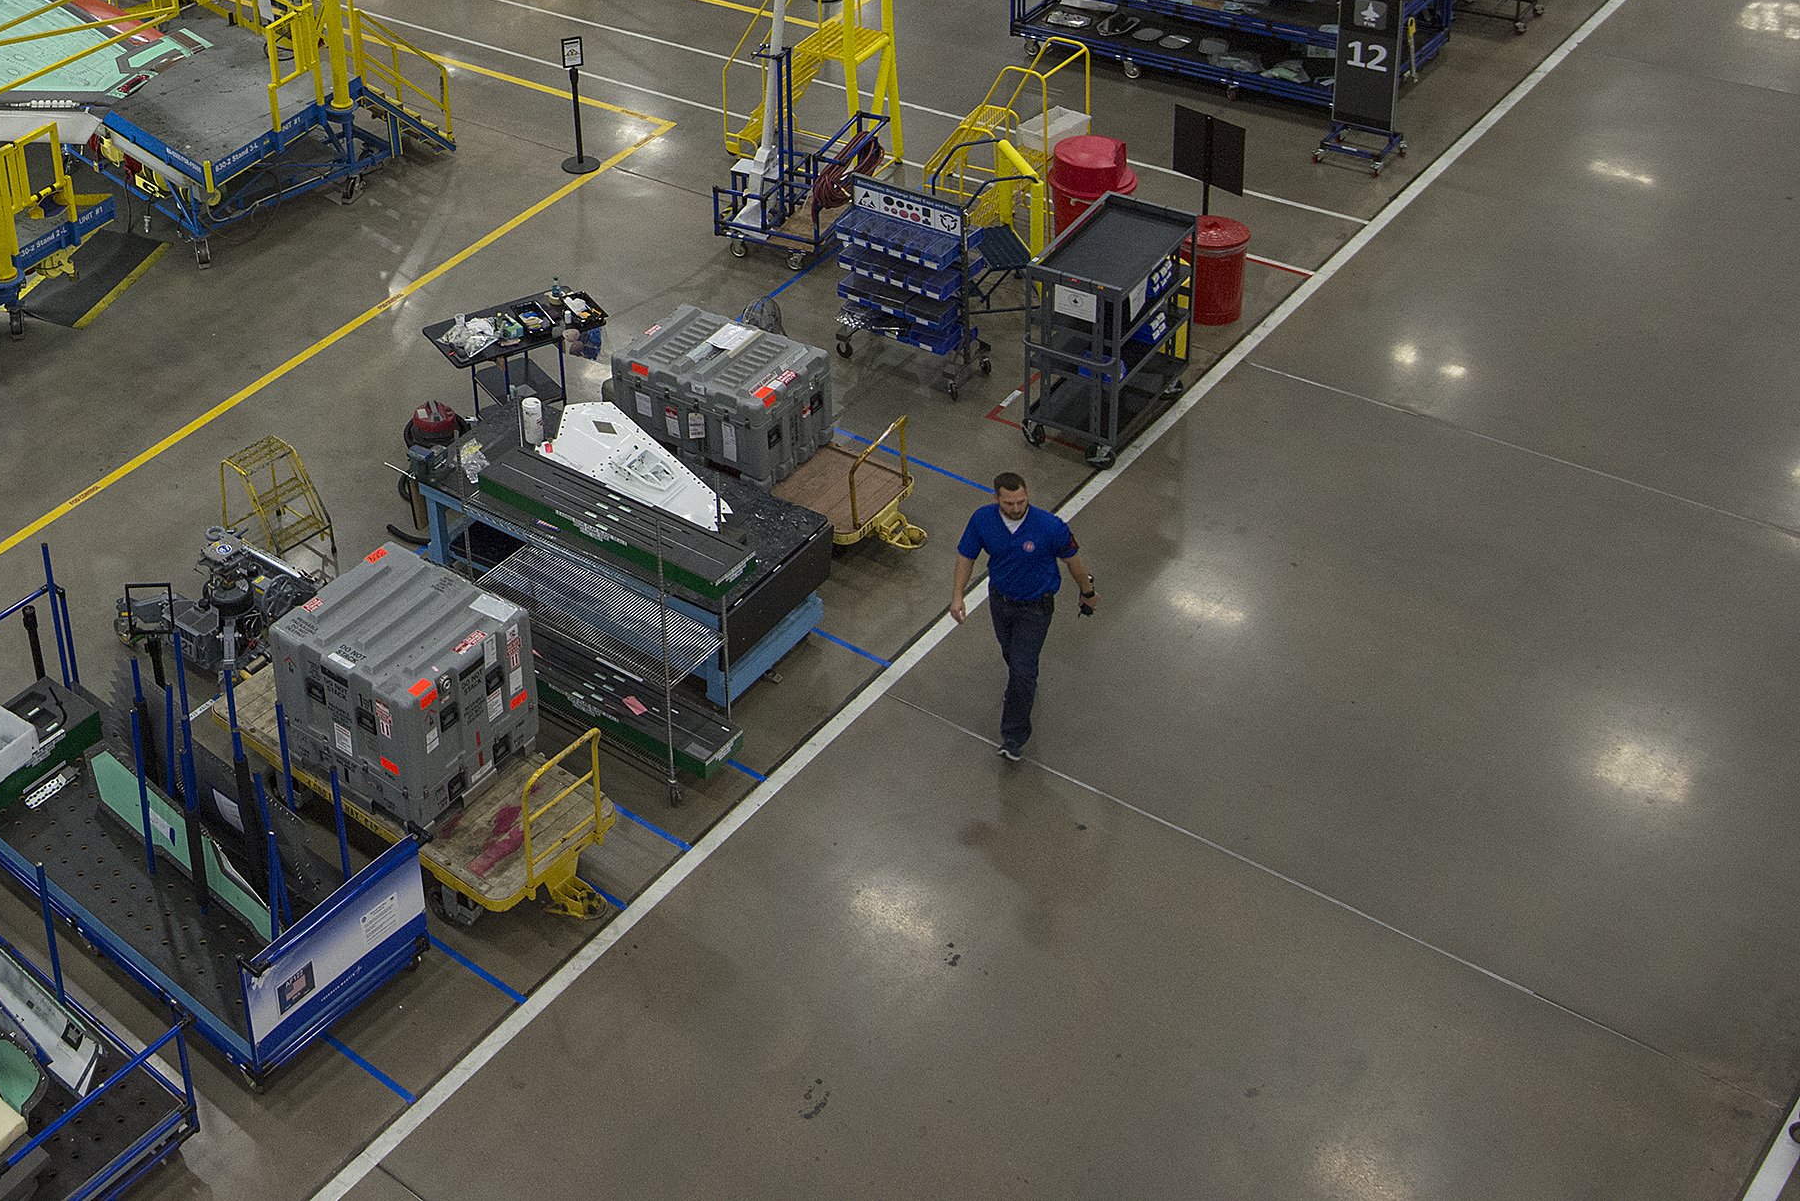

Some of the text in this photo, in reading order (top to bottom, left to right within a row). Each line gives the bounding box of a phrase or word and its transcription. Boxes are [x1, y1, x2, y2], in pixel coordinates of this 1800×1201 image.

[1363, 20, 1377, 29] FIN
[1346, 40, 1389, 73] 12
[36, 233, 55, 248] Stand
[336, 649, 359, 664] STACK
[340, 644, 368, 661] DO NOT
[461, 668, 483, 690] DO NOT
[463, 677, 482, 696] STACK
[334, 684, 348, 695] NOT
[285, 969, 304, 989] AF122
